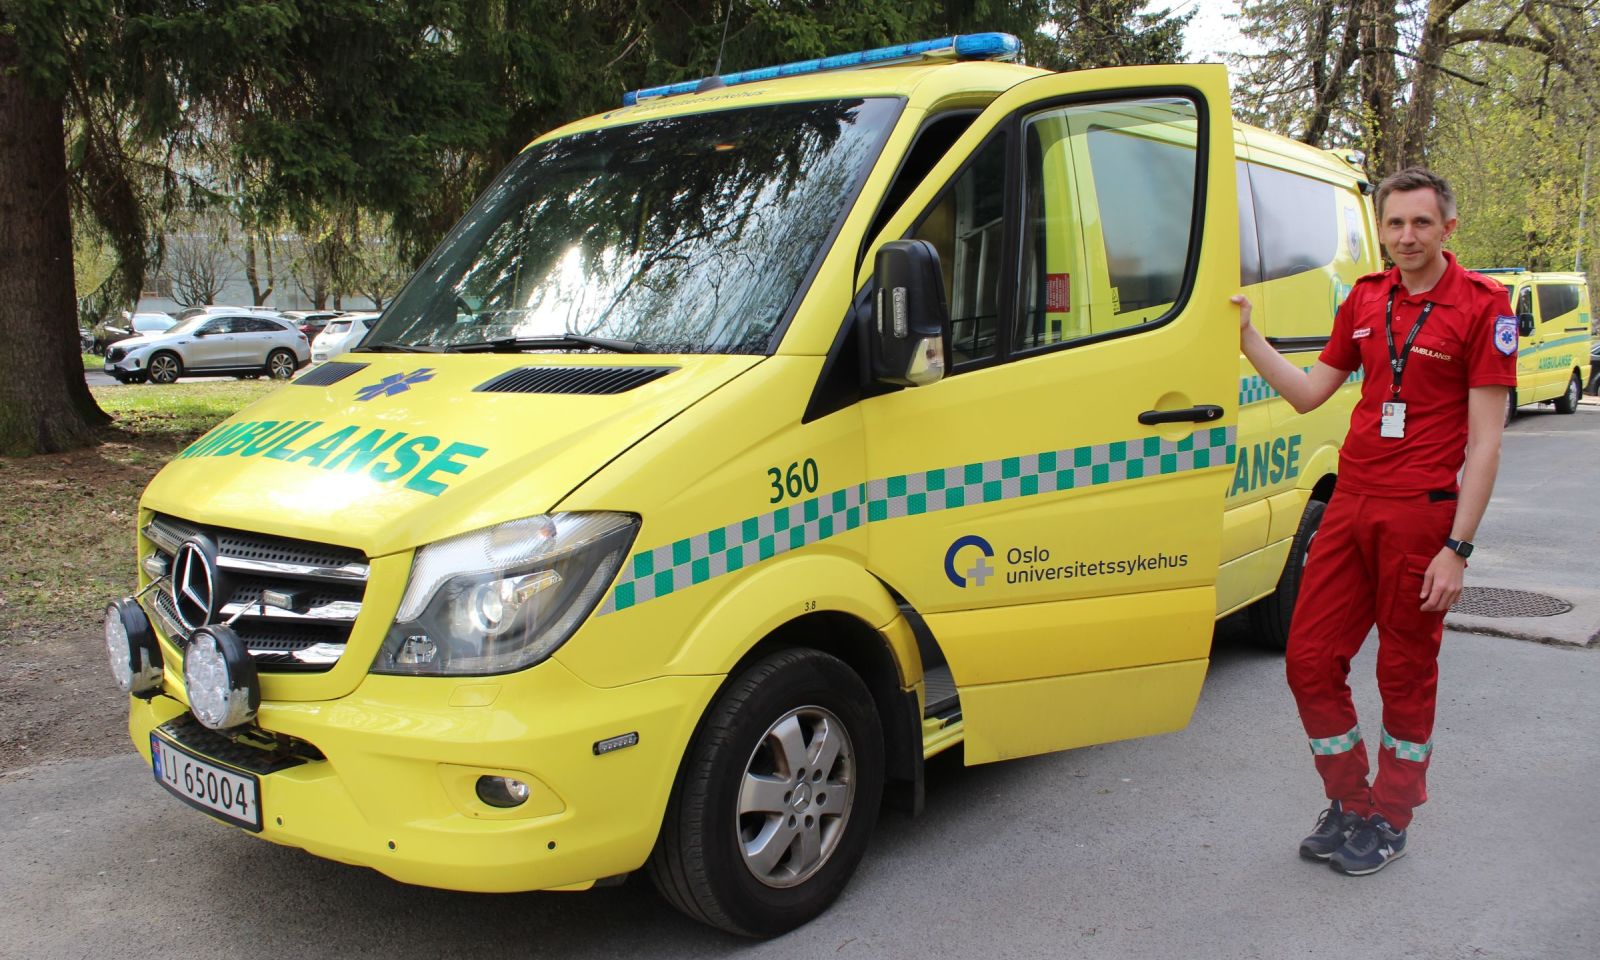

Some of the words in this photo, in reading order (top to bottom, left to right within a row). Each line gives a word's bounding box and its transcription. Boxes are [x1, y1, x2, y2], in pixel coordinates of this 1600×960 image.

[1410, 345, 1452, 361] AMBULANSE
[175, 420, 489, 497] AMBULANSE
[767, 457, 819, 504] 360
[1225, 434, 1301, 498] ANSE
[1006, 553, 1189, 584] universitetssykehus
[1007, 546, 1050, 565] Oslo
[163, 748, 178, 785] LJ
[184, 762, 248, 816] 65004
